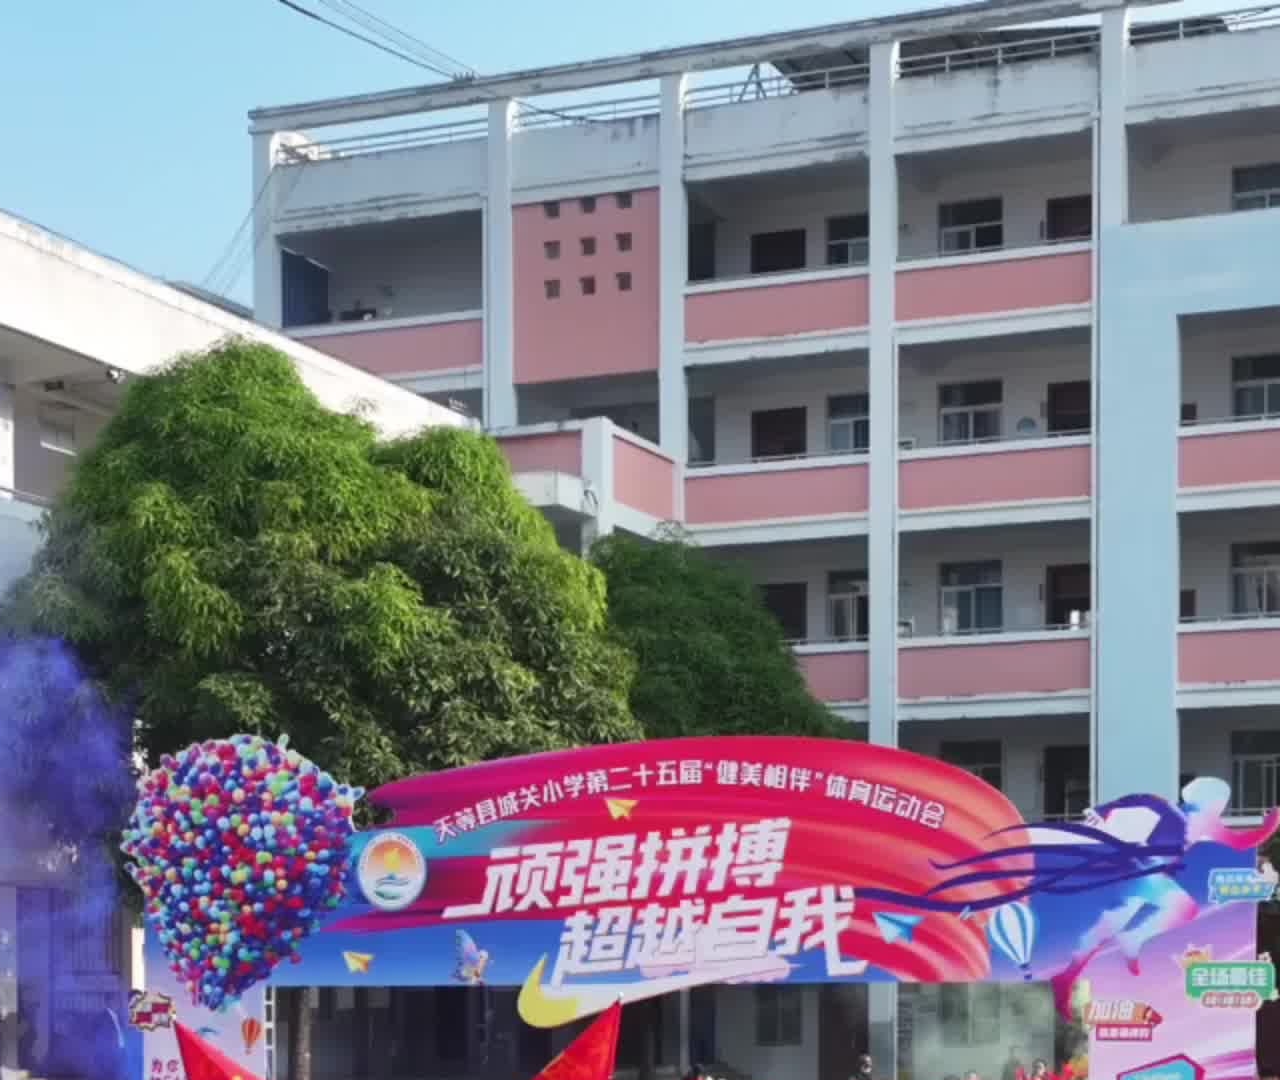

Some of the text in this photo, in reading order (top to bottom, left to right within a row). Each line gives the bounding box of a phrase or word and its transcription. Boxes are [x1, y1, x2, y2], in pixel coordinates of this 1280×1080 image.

[441, 816, 792, 919] 顽强拼搏
[550, 884, 869, 988] 超越自我
